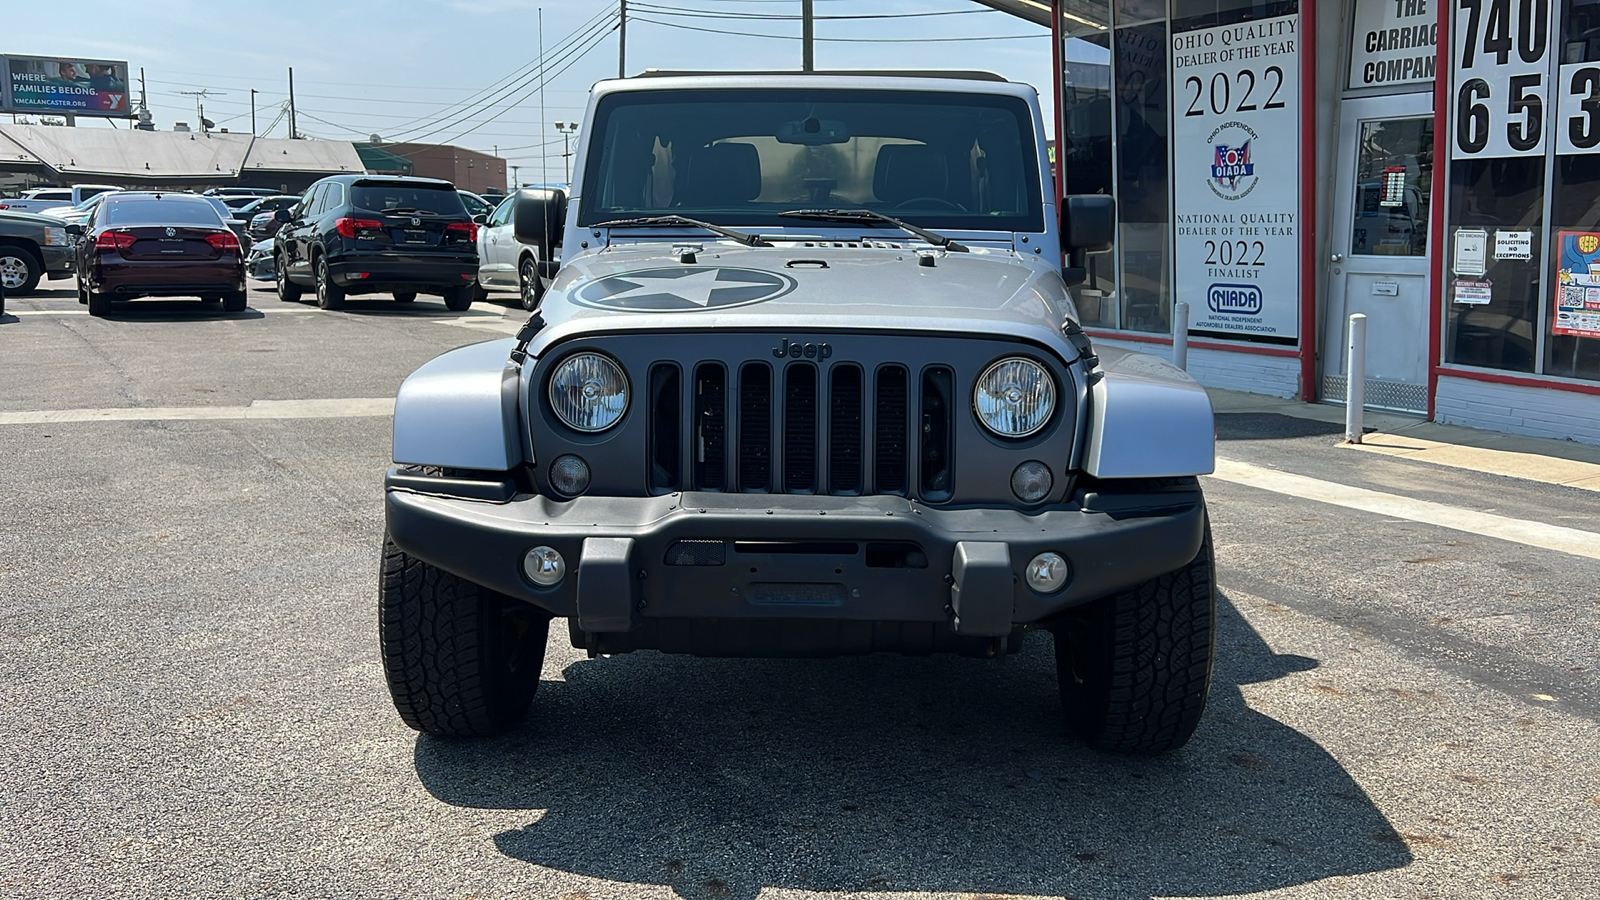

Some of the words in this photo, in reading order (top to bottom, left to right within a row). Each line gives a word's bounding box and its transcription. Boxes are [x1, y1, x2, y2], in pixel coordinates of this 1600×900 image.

[1395, 0, 1427, 18] THE
[1174, 32, 1214, 51] OHIO
[1221, 18, 1297, 46] QUALITY
[1365, 23, 1438, 53] CARRIAG
[1459, 0, 1547, 69] 740
[1176, 51, 1217, 69] DEALER
[1219, 48, 1234, 62] OF
[1237, 45, 1260, 60] THE
[1263, 40, 1295, 56] YEAR
[12, 72, 46, 82] WHERE
[1363, 55, 1437, 84] COMPAN
[13, 84, 57, 94] FAMILIES
[58, 86, 99, 96] BELONG.
[1185, 65, 1286, 117] 2022
[14, 98, 87, 107] YMCALANCASTER.ORG
[1207, 127, 1220, 144] OHIO
[1219, 121, 1259, 141] INDEPENDENT
[1216, 164, 1247, 177] OIADA
[1177, 214, 1236, 224] NATIONAL
[1240, 213, 1295, 225] QUALITY
[1178, 227, 1217, 236] DEALER
[1221, 227, 1234, 236] OF
[1239, 227, 1260, 236] THE
[1264, 227, 1294, 236] YEAR
[1204, 240, 1266, 266] 2022
[1579, 235, 1598, 253] BEER
[1208, 268, 1260, 279] FINALIST
[1196, 321, 1223, 329] AUTOMOBILE
[1244, 325, 1277, 333] ASSOCIATION
[1231, 316, 1263, 324] INDEPENDENT
[772, 337, 833, 362] Jeep
